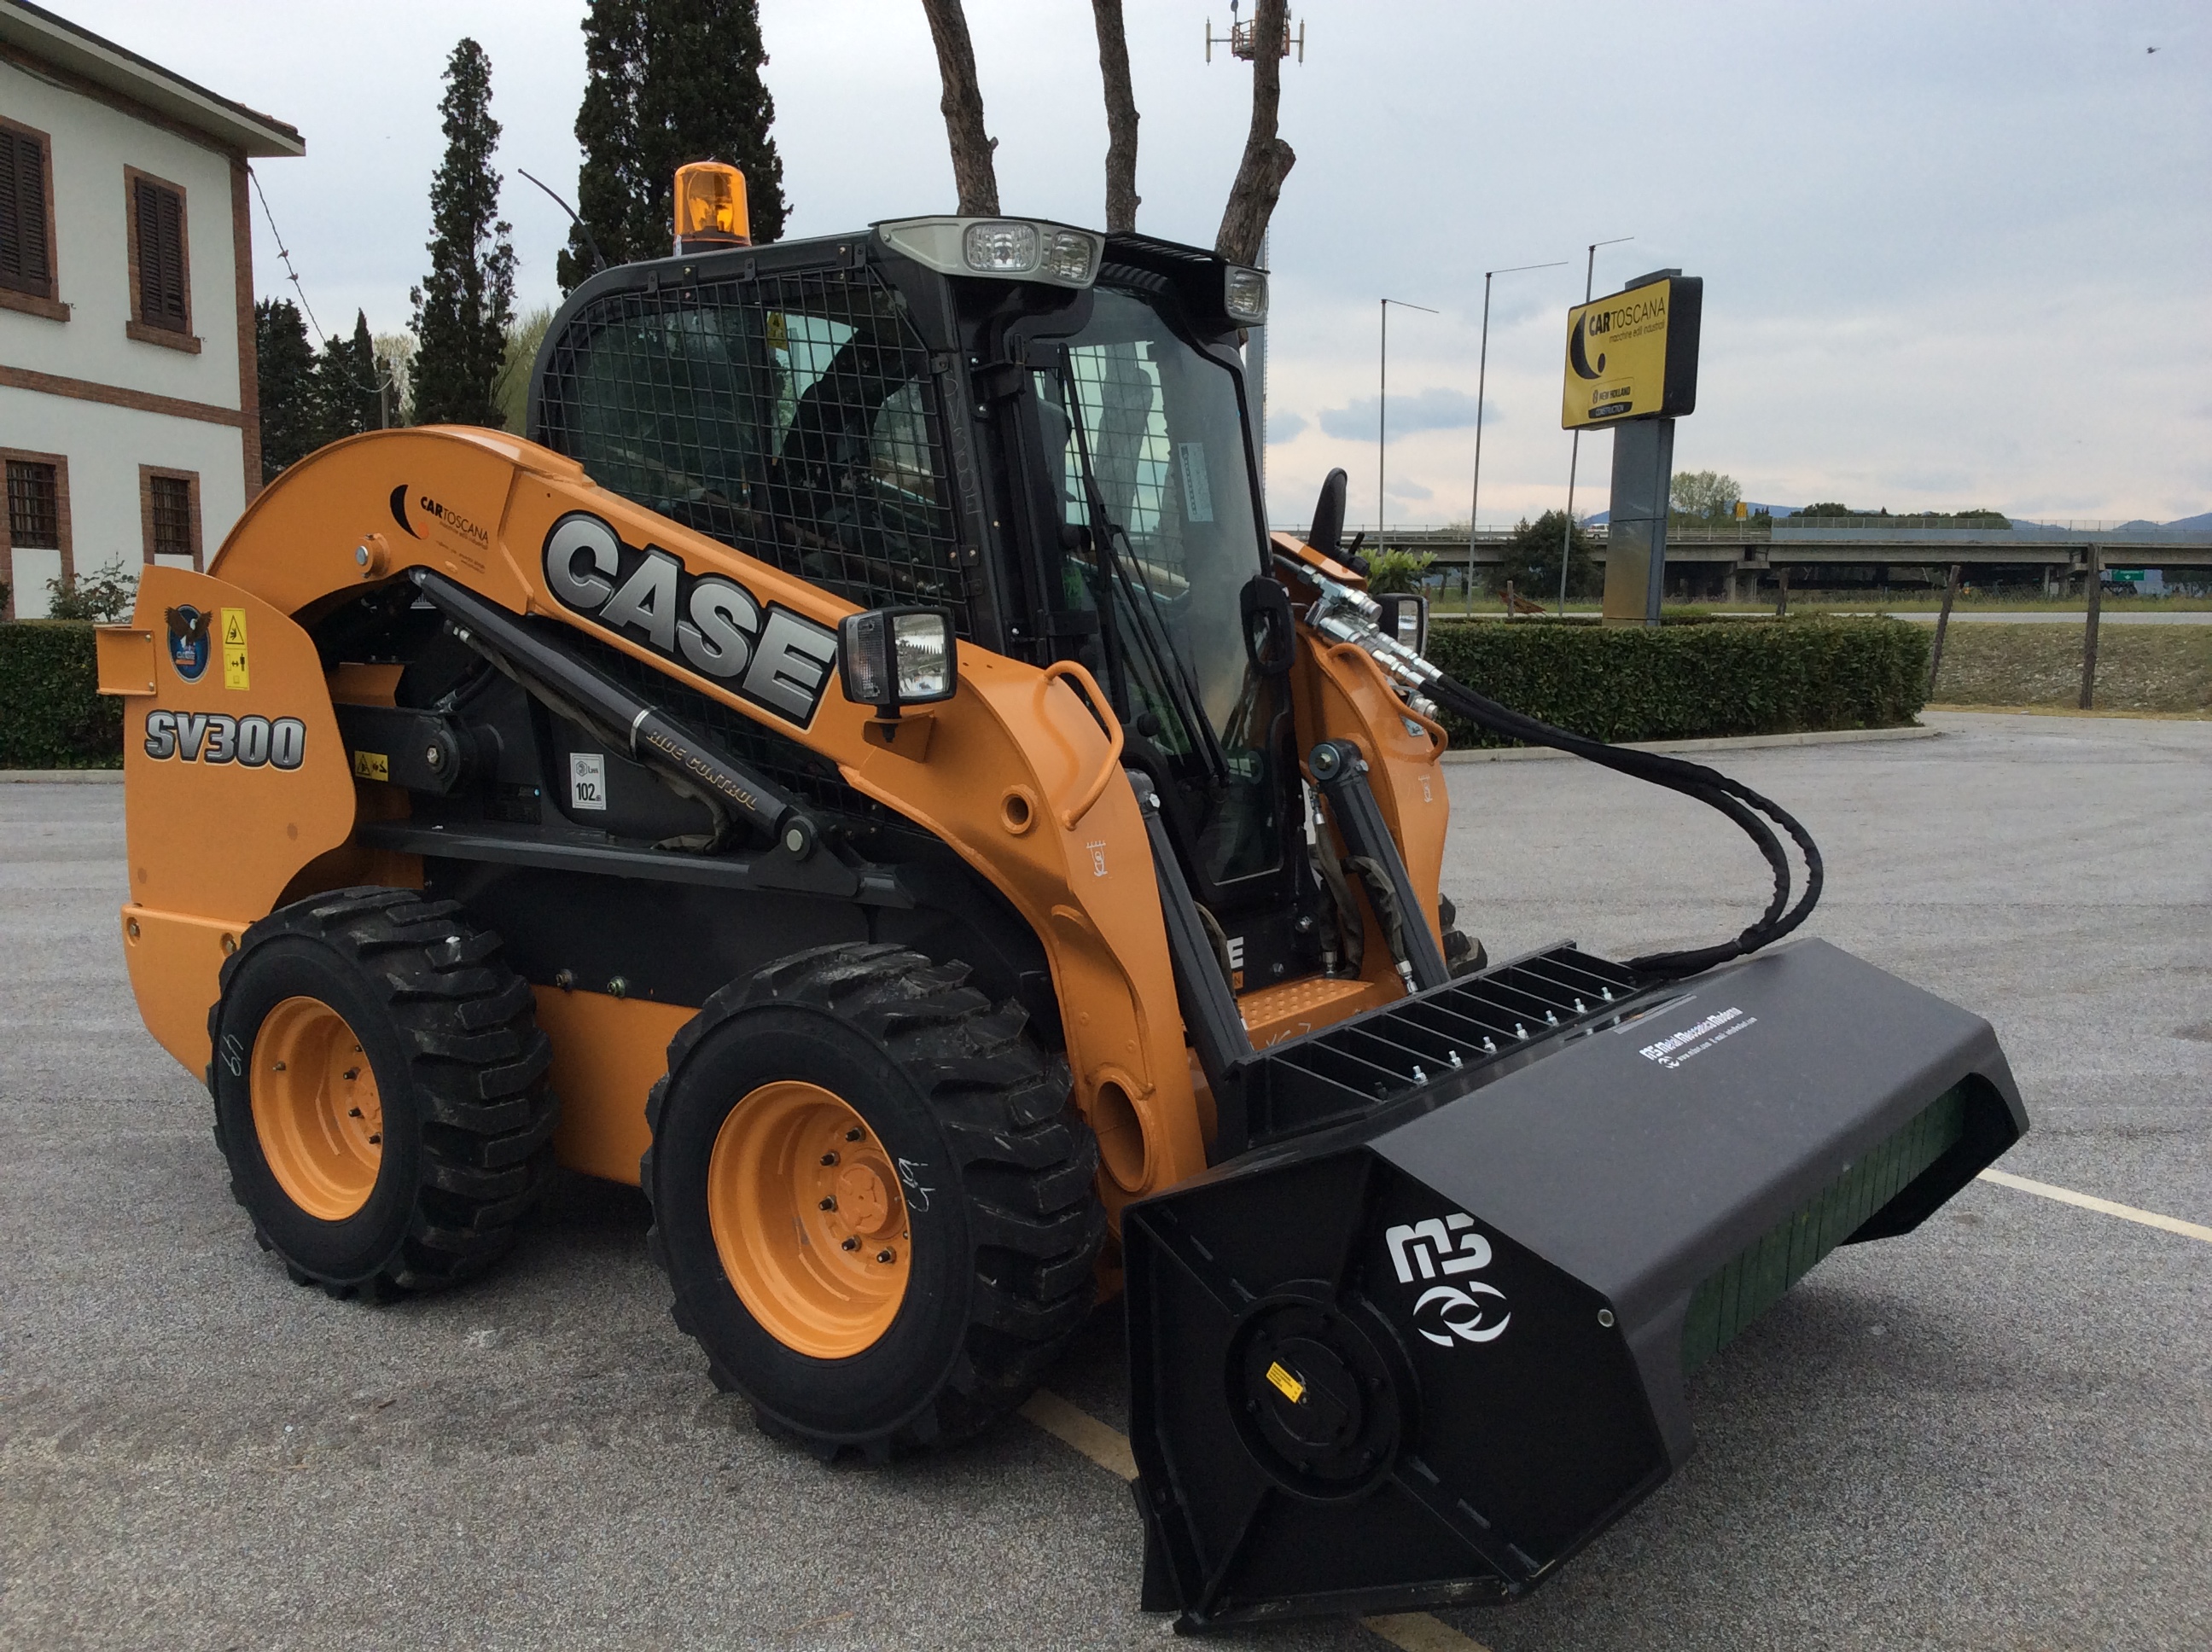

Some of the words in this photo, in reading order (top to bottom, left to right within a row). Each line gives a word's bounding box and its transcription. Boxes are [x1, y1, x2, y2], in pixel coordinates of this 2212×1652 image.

[1588, 296, 1666, 337] CARTOSCANA
[420, 496, 489, 544] CARTOSCANA
[544, 513, 838, 725] CASE
[145, 710, 306, 771] SV300
[576, 782, 596, 801] 102
[646, 728, 687, 761] RIDE
[685, 755, 757, 811] CONTROL
